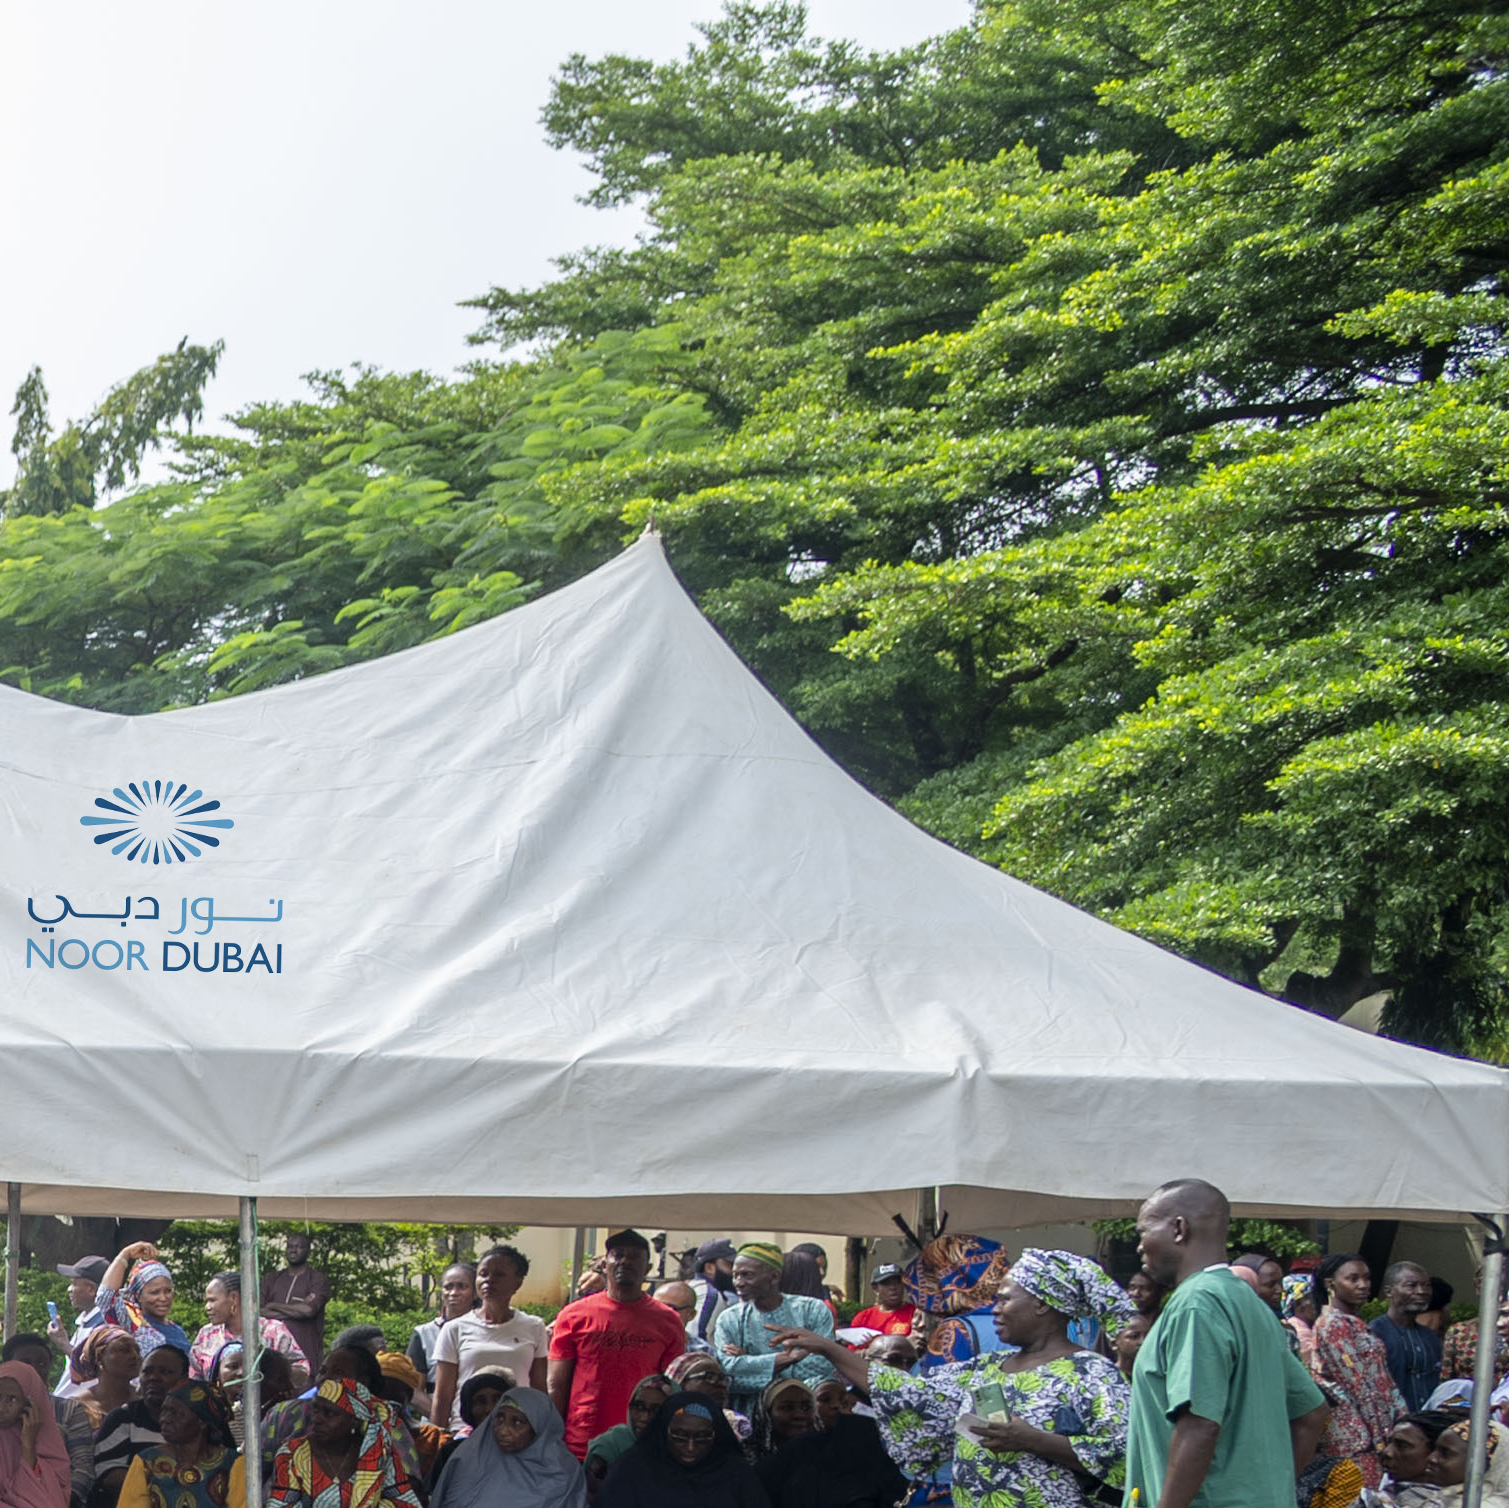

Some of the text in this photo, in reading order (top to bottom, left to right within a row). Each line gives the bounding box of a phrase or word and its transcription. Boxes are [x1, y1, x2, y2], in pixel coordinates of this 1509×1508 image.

[27, 894, 283, 935] نور دبي
[26, 938, 283, 974] NOOR DUBAI
